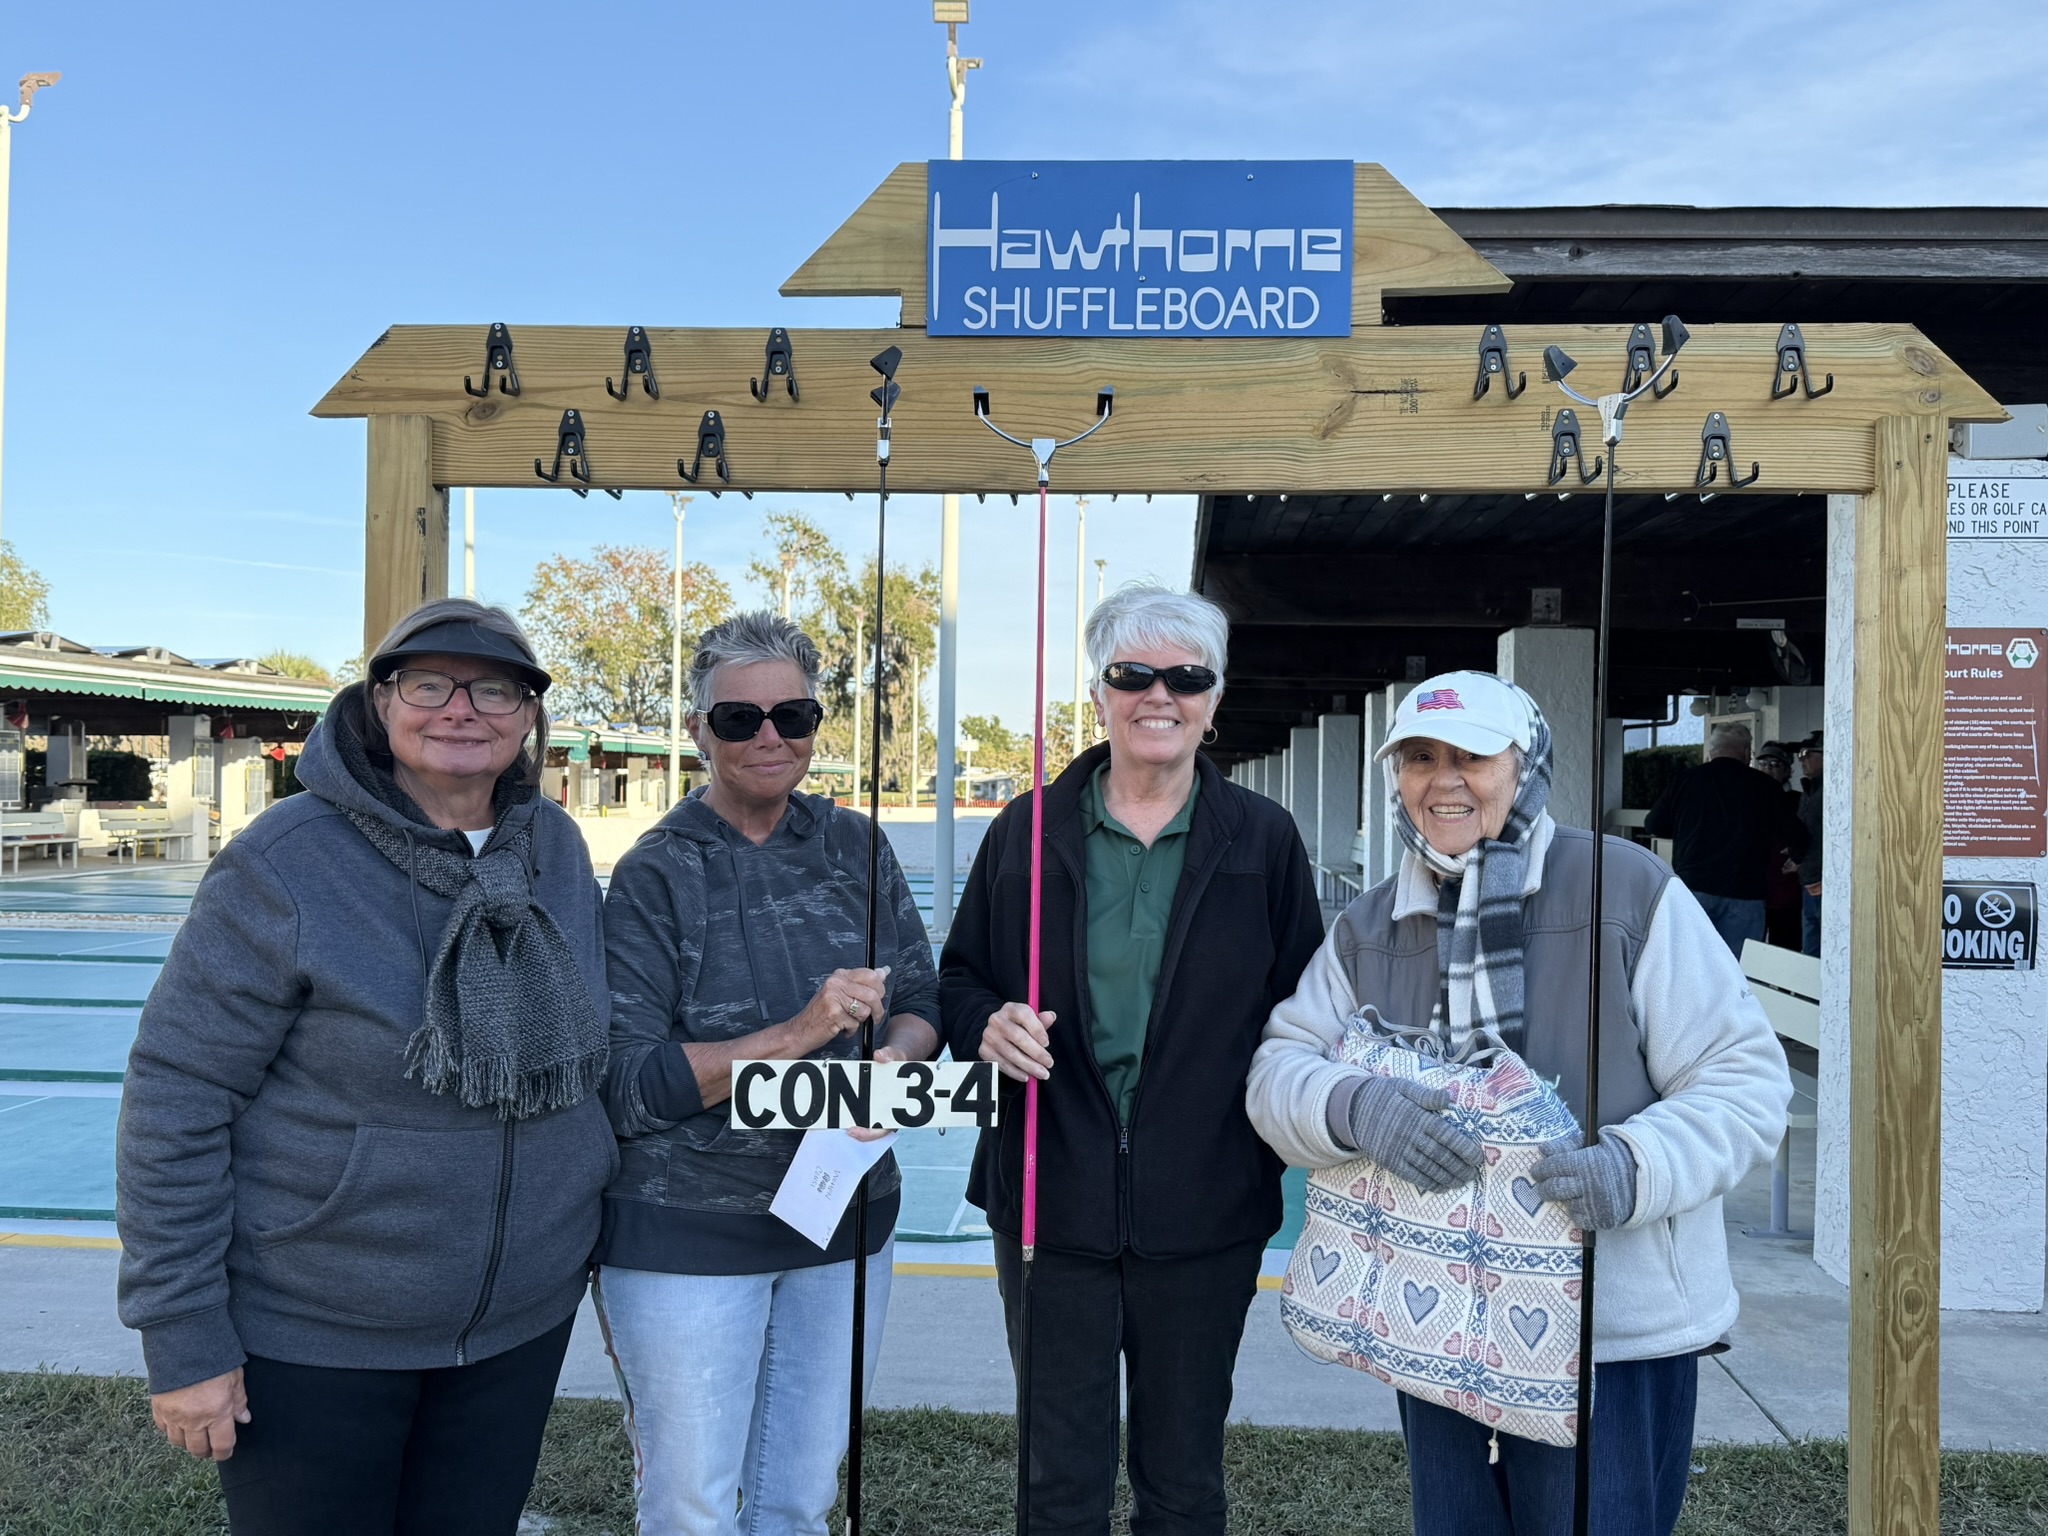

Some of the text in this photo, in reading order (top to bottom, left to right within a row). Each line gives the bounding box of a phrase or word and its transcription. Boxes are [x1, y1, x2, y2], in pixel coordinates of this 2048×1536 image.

[933, 191, 1342, 321] Hawthorne
[963, 286, 1319, 330] SHUFFLEBOARD
[1947, 483, 2010, 498] PLEASE
[1947, 502, 1965, 515] ES
[1971, 502, 1987, 515] OR
[1994, 502, 2025, 515] GOLF
[1949, 520, 2039, 533] ND THIS POINT
[1944, 668, 2004, 678] ourt Rules
[1944, 894, 1962, 924] O
[1942, 929, 2024, 960] OKING
[892, 1062, 996, 1128] 3-4
